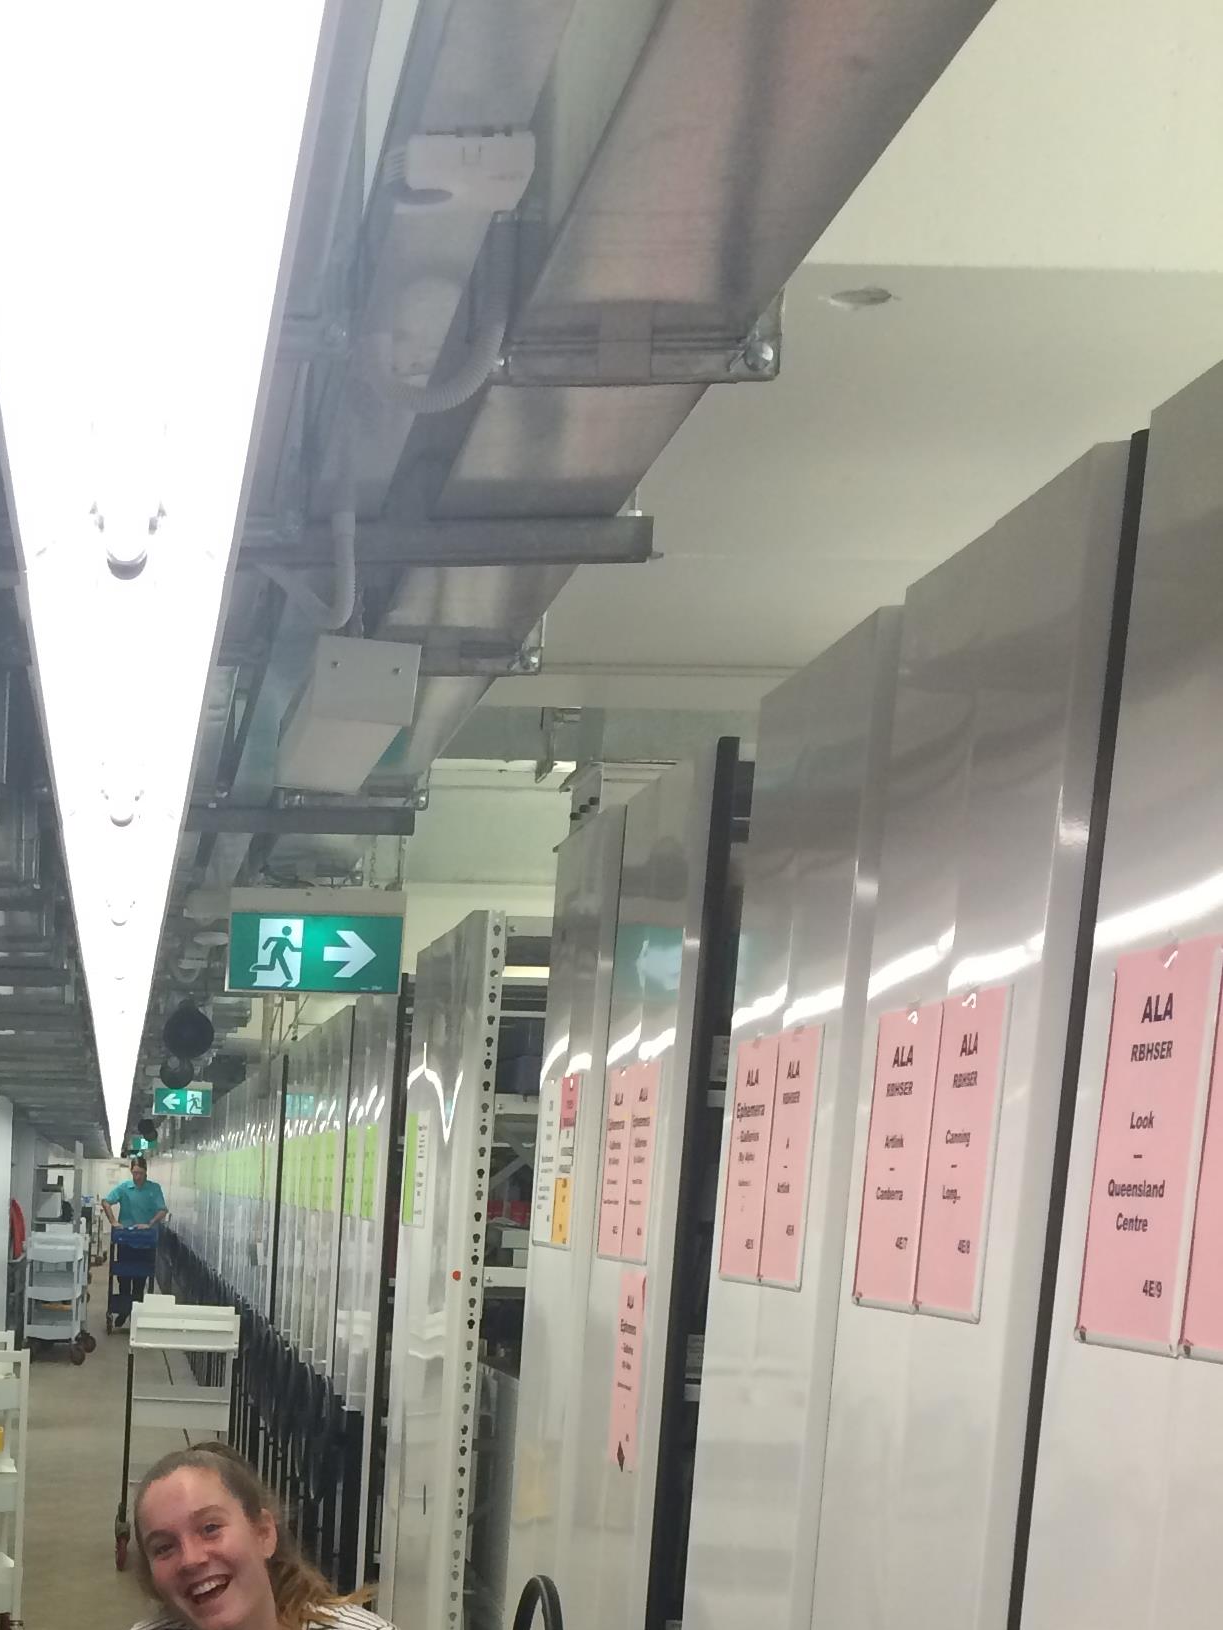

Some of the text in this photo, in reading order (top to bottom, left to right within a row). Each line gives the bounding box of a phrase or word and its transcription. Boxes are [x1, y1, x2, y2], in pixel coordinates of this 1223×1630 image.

[1141, 992, 1174, 1023] ALA
[960, 1032, 978, 1057] ALA
[1130, 1040, 1174, 1062] RBHSER
[892, 1045, 914, 1068] ALA
[787, 1060, 800, 1079] ALA
[1129, 1110, 1155, 1130] Look
[1107, 1178, 1166, 1198] Queensland
[1115, 1212, 1149, 1233] Centre
